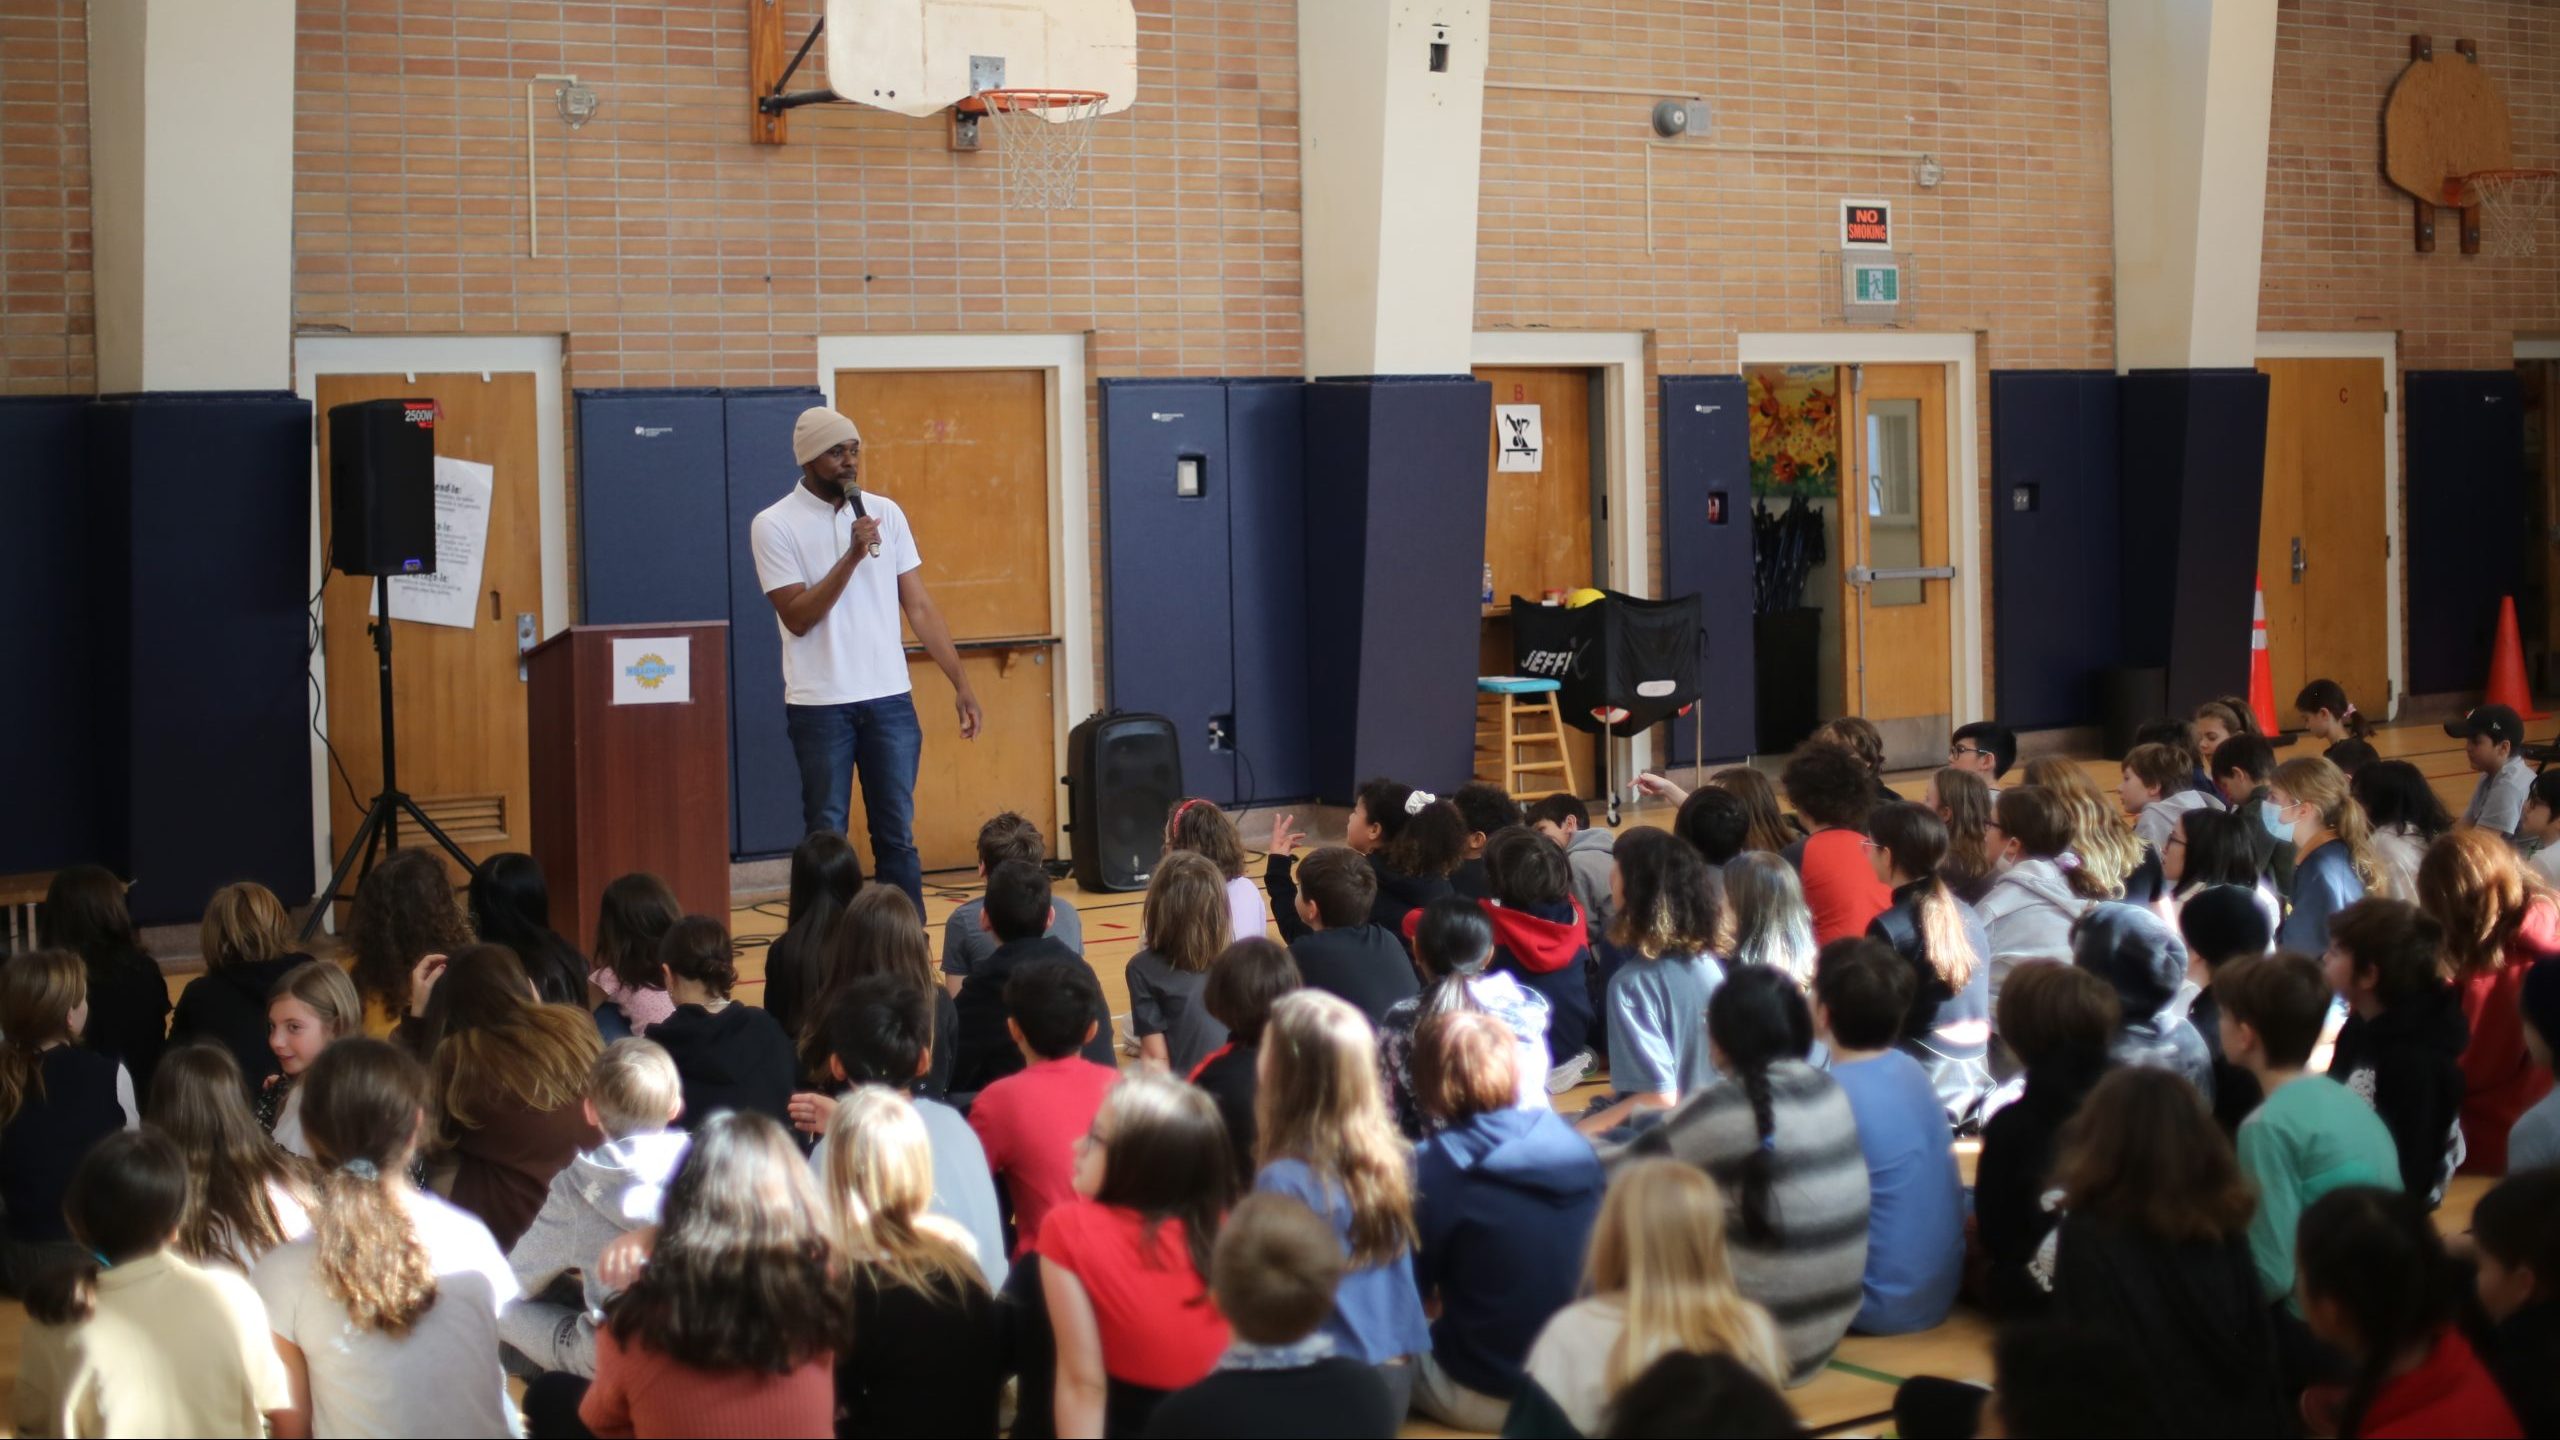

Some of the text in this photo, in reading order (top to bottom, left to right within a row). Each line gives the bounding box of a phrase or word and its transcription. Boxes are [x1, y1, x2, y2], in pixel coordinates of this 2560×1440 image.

[1855, 209, 1878, 223] NO
[1848, 223, 1886, 239] SMOKING
[1514, 383, 1524, 401] B
[2339, 387, 2348, 404] C
